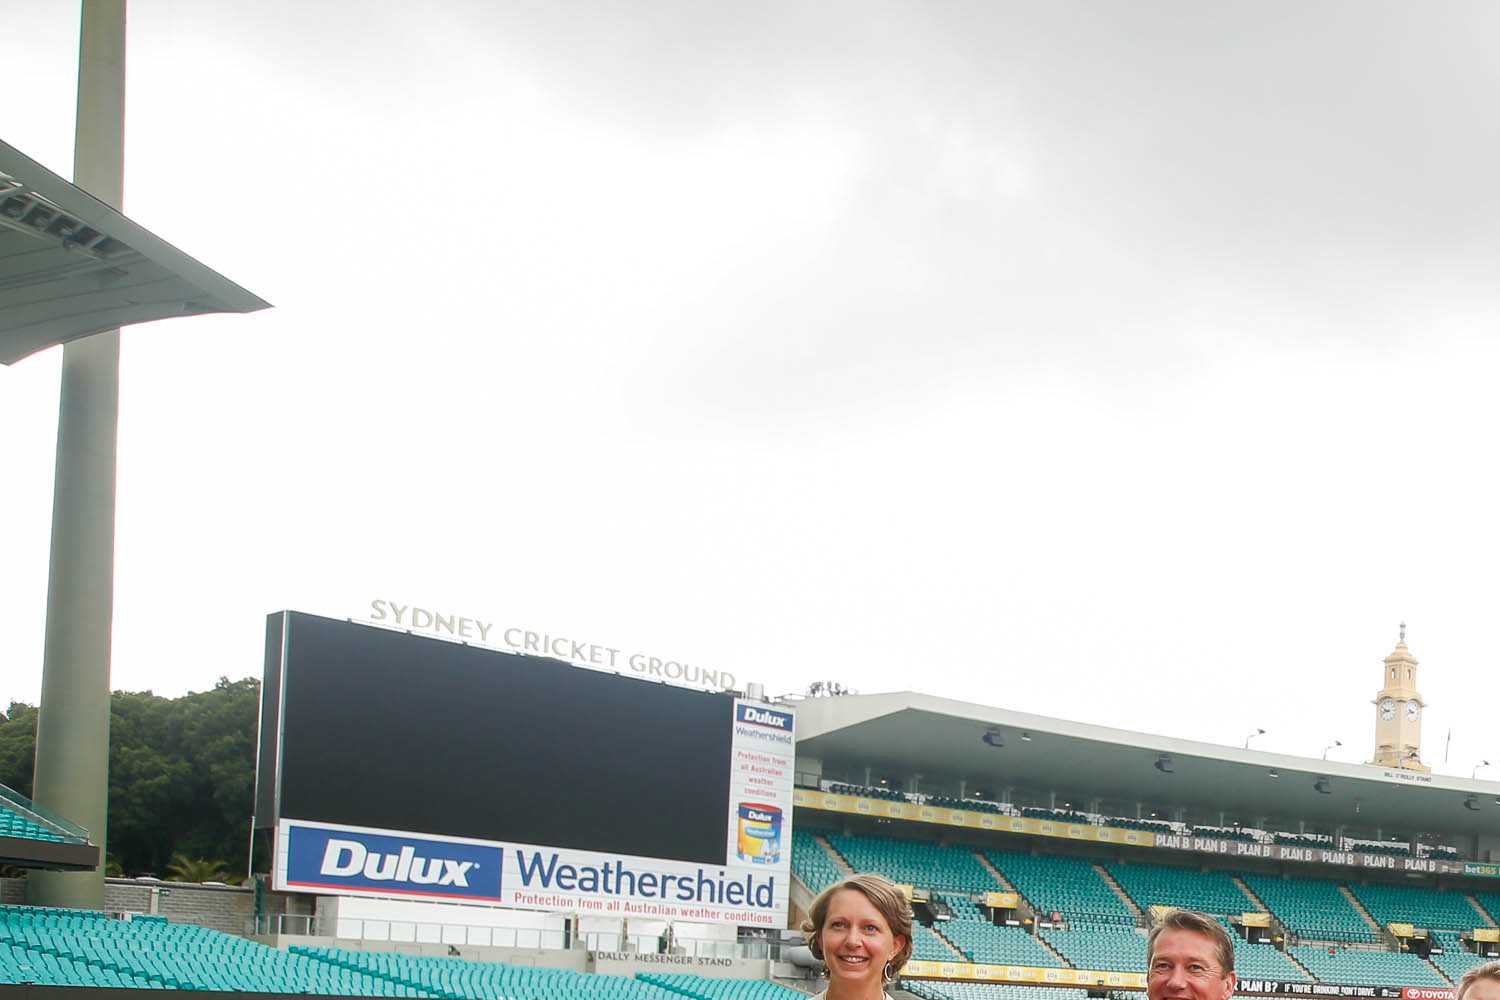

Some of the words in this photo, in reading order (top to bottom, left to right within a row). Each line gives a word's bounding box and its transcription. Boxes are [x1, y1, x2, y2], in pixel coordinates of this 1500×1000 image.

[370, 599, 493, 641] SYDNEY
[503, 627, 621, 667] CRICKET
[629, 653, 737, 690] GROUND
[744, 707, 786, 728] Dulux
[736, 726, 791, 745] Weathershield
[748, 810, 773, 822] Dulux
[320, 838, 470, 887] Dulux
[1156, 834, 1179, 848] PLAN
[1182, 836, 1190, 849] B
[1194, 838, 1218, 852] PLAN
[1220, 841, 1227, 853] B
[1237, 843, 1260, 856] PLAN
[1263, 845, 1270, 857] B
[1280, 847, 1302, 860] PLAN
[1305, 850, 1312, 861] B
[1322, 852, 1345, 864] PLAN
[1348, 854, 1354, 865] B
[1363, 856, 1386, 868] PLAN
[1388, 858, 1395, 869] B
[1404, 859, 1427, 871] PLAN
[1429, 861, 1436, 872] B
[516, 849, 774, 909] Weathershield
[1465, 864, 1496, 875] bet365
[514, 891, 574, 908] Protection
[578, 897, 603, 910] from
[607, 899, 620, 912] all
[624, 901, 677, 917] Australian
[681, 906, 720, 919] weather
[724, 910, 773, 924] conditions
[598, 950, 630, 962] DALLY
[634, 952, 693, 965] MESSENGER
[698, 956, 733, 967] STAND
[1241, 980, 1263, 992] PLAN
[1264, 981, 1278, 993] B?
[1284, 983, 1291, 993] IF
[1421, 990, 1455, 1000] TOYOTA
